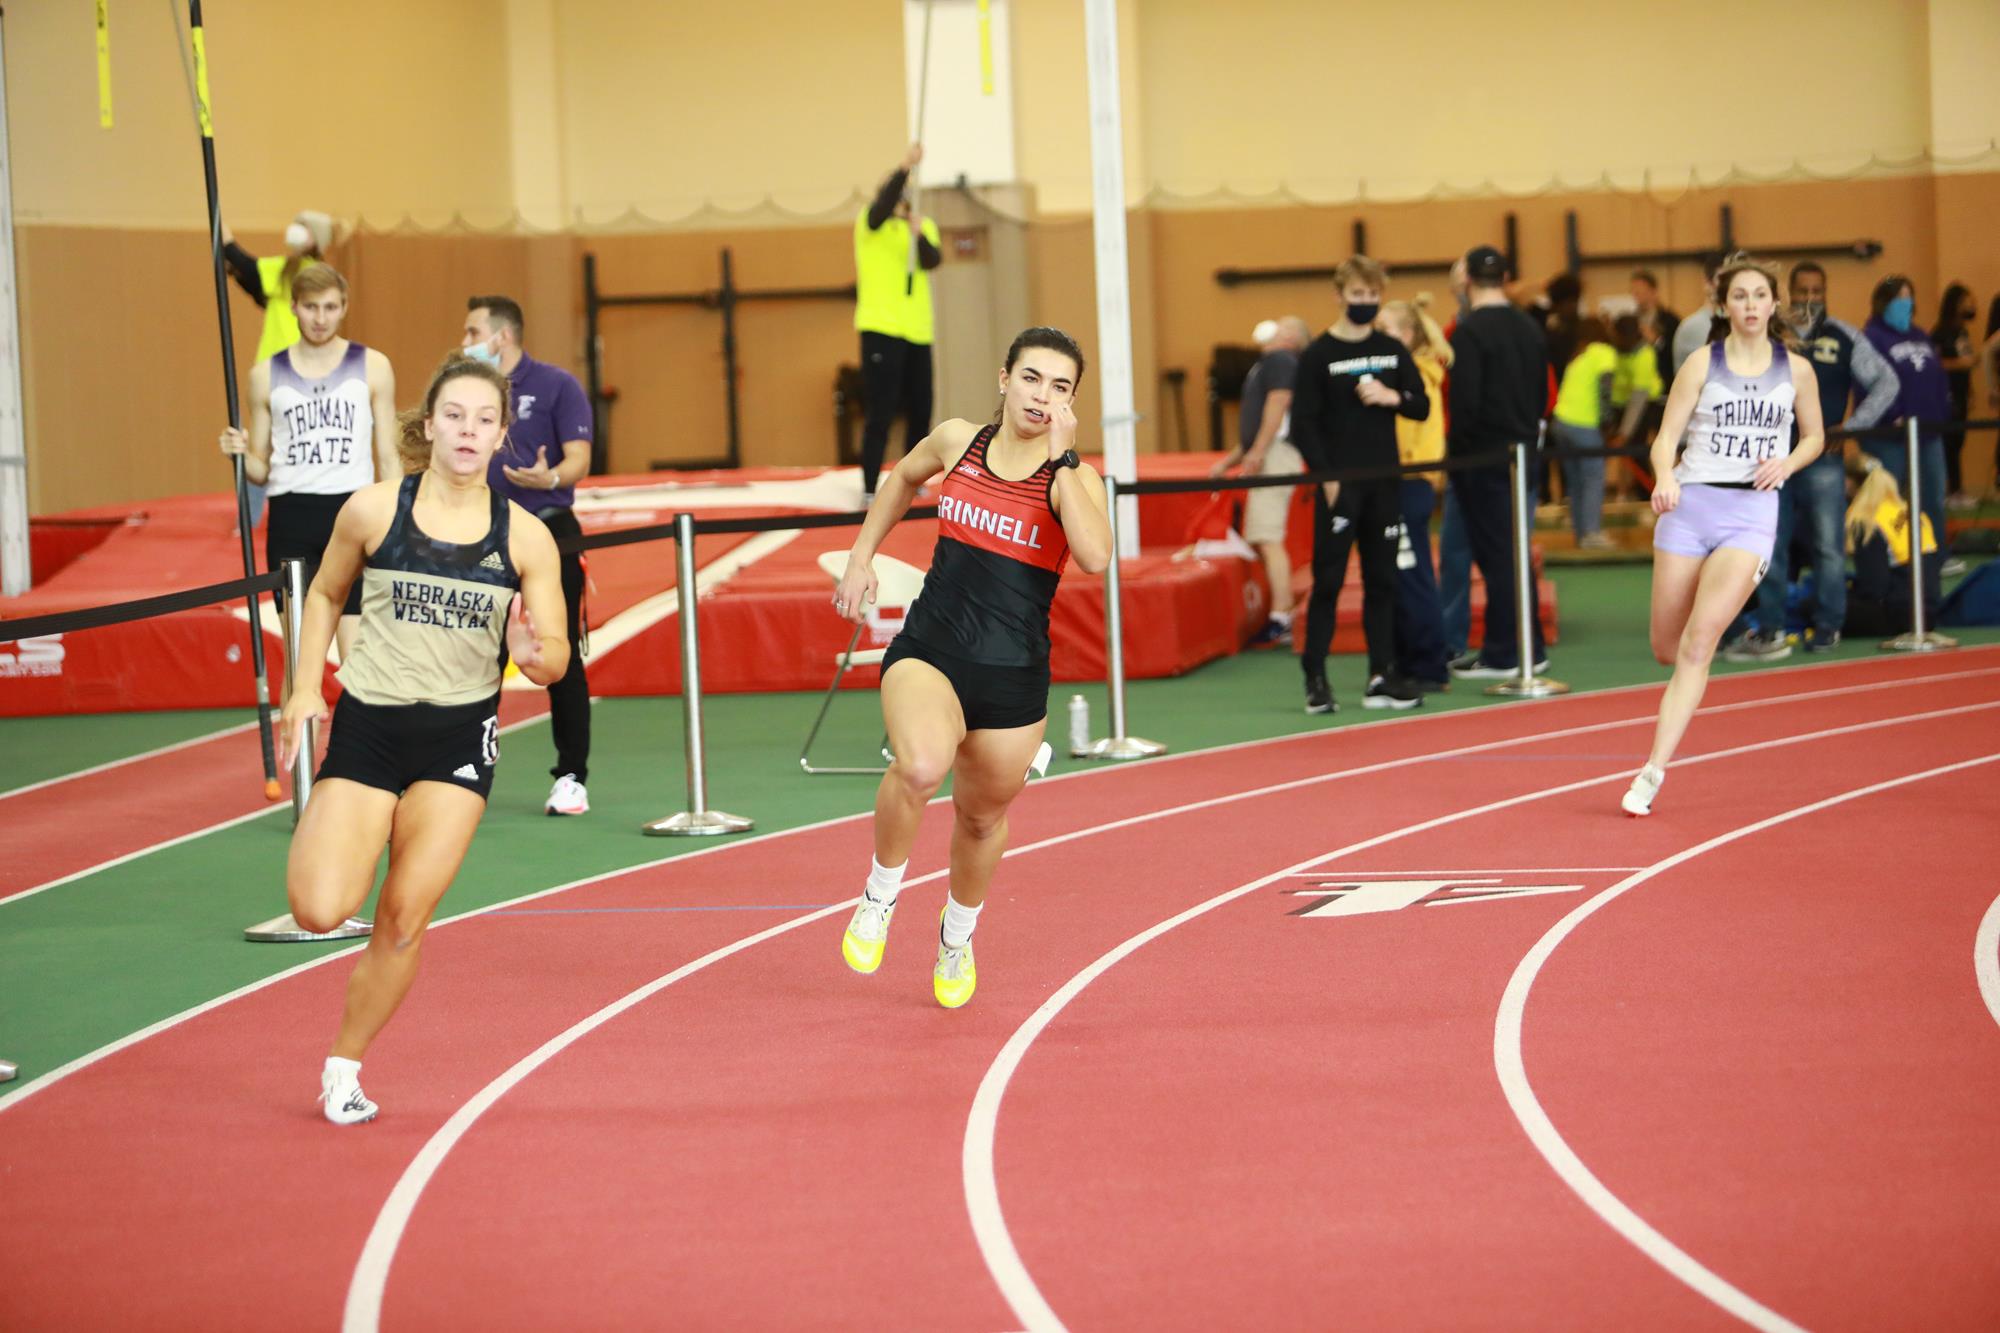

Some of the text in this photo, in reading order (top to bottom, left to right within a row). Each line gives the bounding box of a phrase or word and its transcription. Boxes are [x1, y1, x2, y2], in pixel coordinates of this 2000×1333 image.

[283, 397, 355, 440] TRUMAN
[1712, 398, 1786, 429] TRUMAN
[285, 437, 353, 465] STATE
[1710, 431, 1778, 460] STATE
[938, 494, 1042, 549] RINNELL
[392, 580, 494, 612] NEBRASKA
